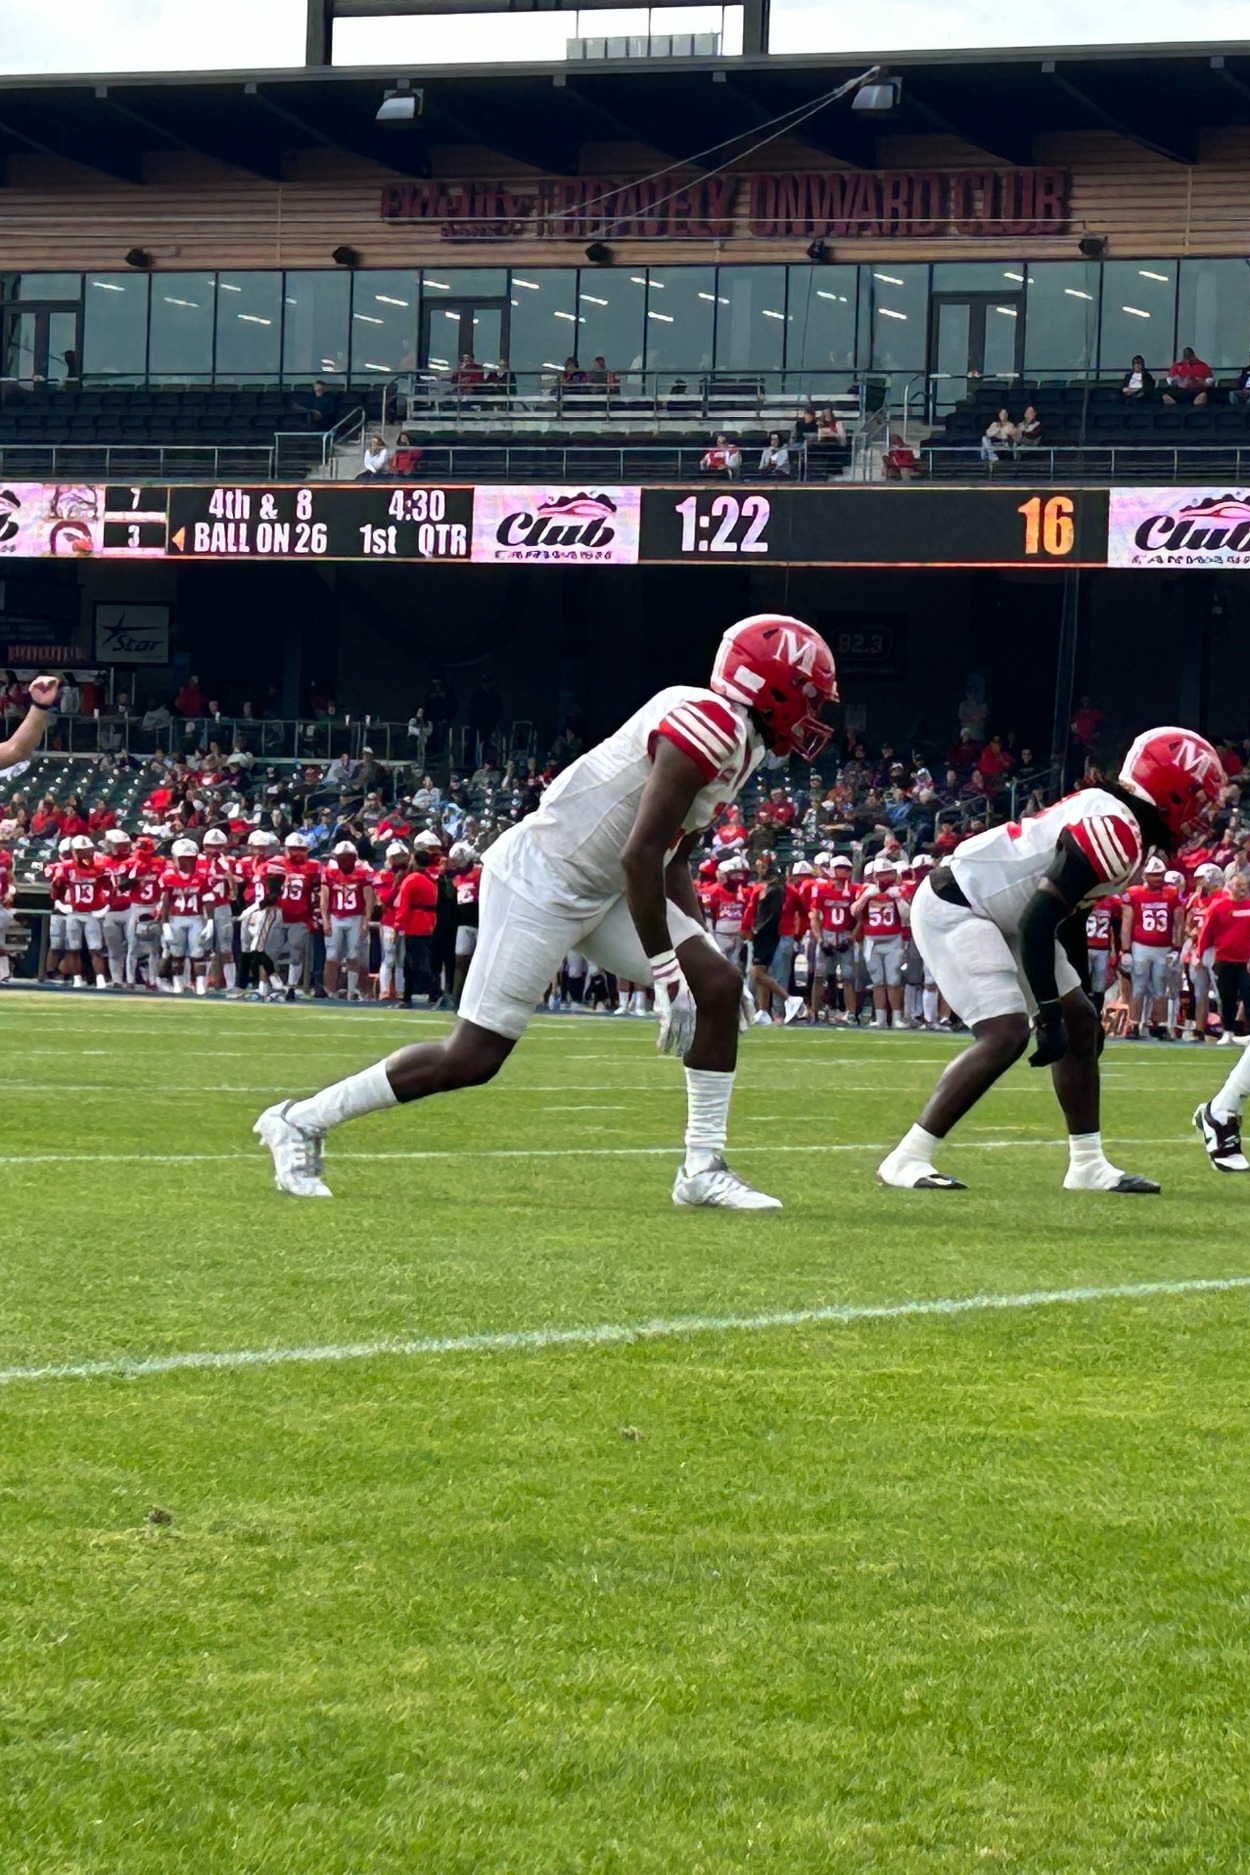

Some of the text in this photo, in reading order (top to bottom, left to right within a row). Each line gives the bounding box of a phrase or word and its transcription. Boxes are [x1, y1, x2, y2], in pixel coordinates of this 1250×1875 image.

[749, 172, 942, 238] ONWARD
[951, 168, 1068, 236] CLUB
[208, 488, 312, 520] 4th & 8
[388, 489, 446, 521] 4:30
[128, 525, 140, 548] 3
[194, 522, 328, 554] BALL ON 26
[495, 511, 615, 547] Club
[675, 494, 771, 552] 1:22
[1018, 495, 1075, 555] 16
[359, 524, 467, 557] 1st QTR
[112, 634, 164, 652] Star
[772, 626, 817, 677] M
[1172, 738, 1212, 783] M
